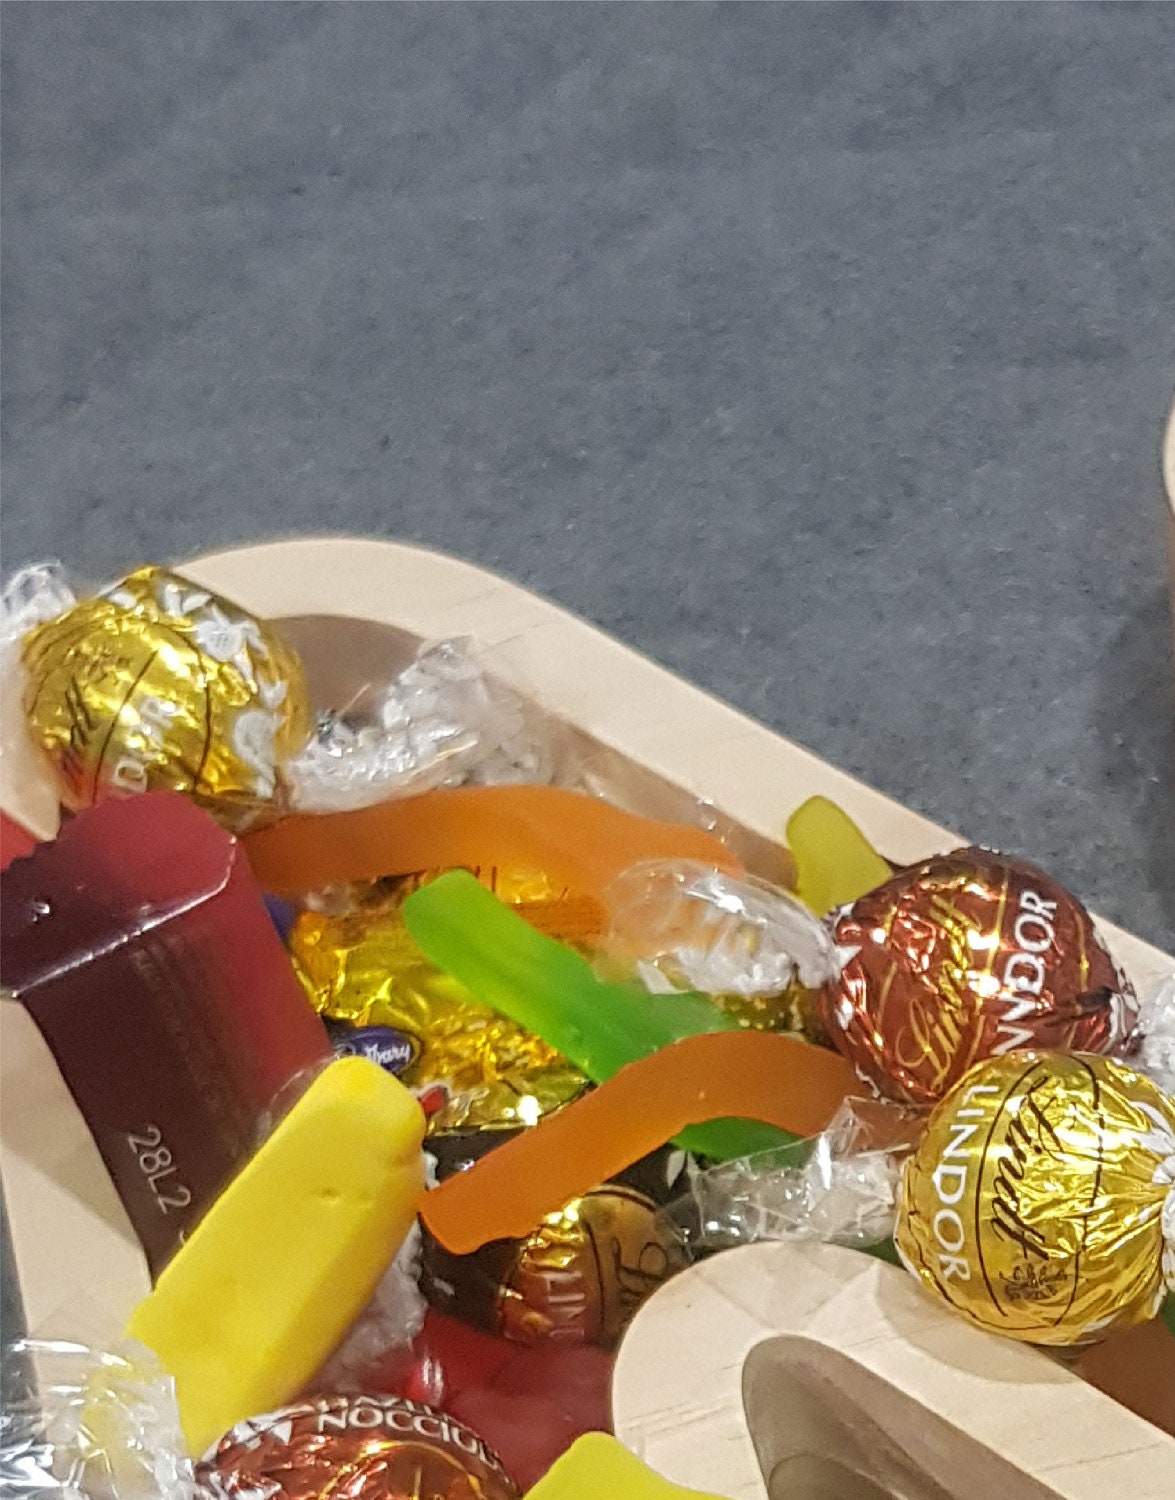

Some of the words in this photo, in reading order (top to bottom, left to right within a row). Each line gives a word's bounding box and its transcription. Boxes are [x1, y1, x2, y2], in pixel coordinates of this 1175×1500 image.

[127, 1122, 192, 1215] 28L2
[932, 1085, 1000, 1282] LINDOR
[988, 1075, 1085, 1261] Lindt
